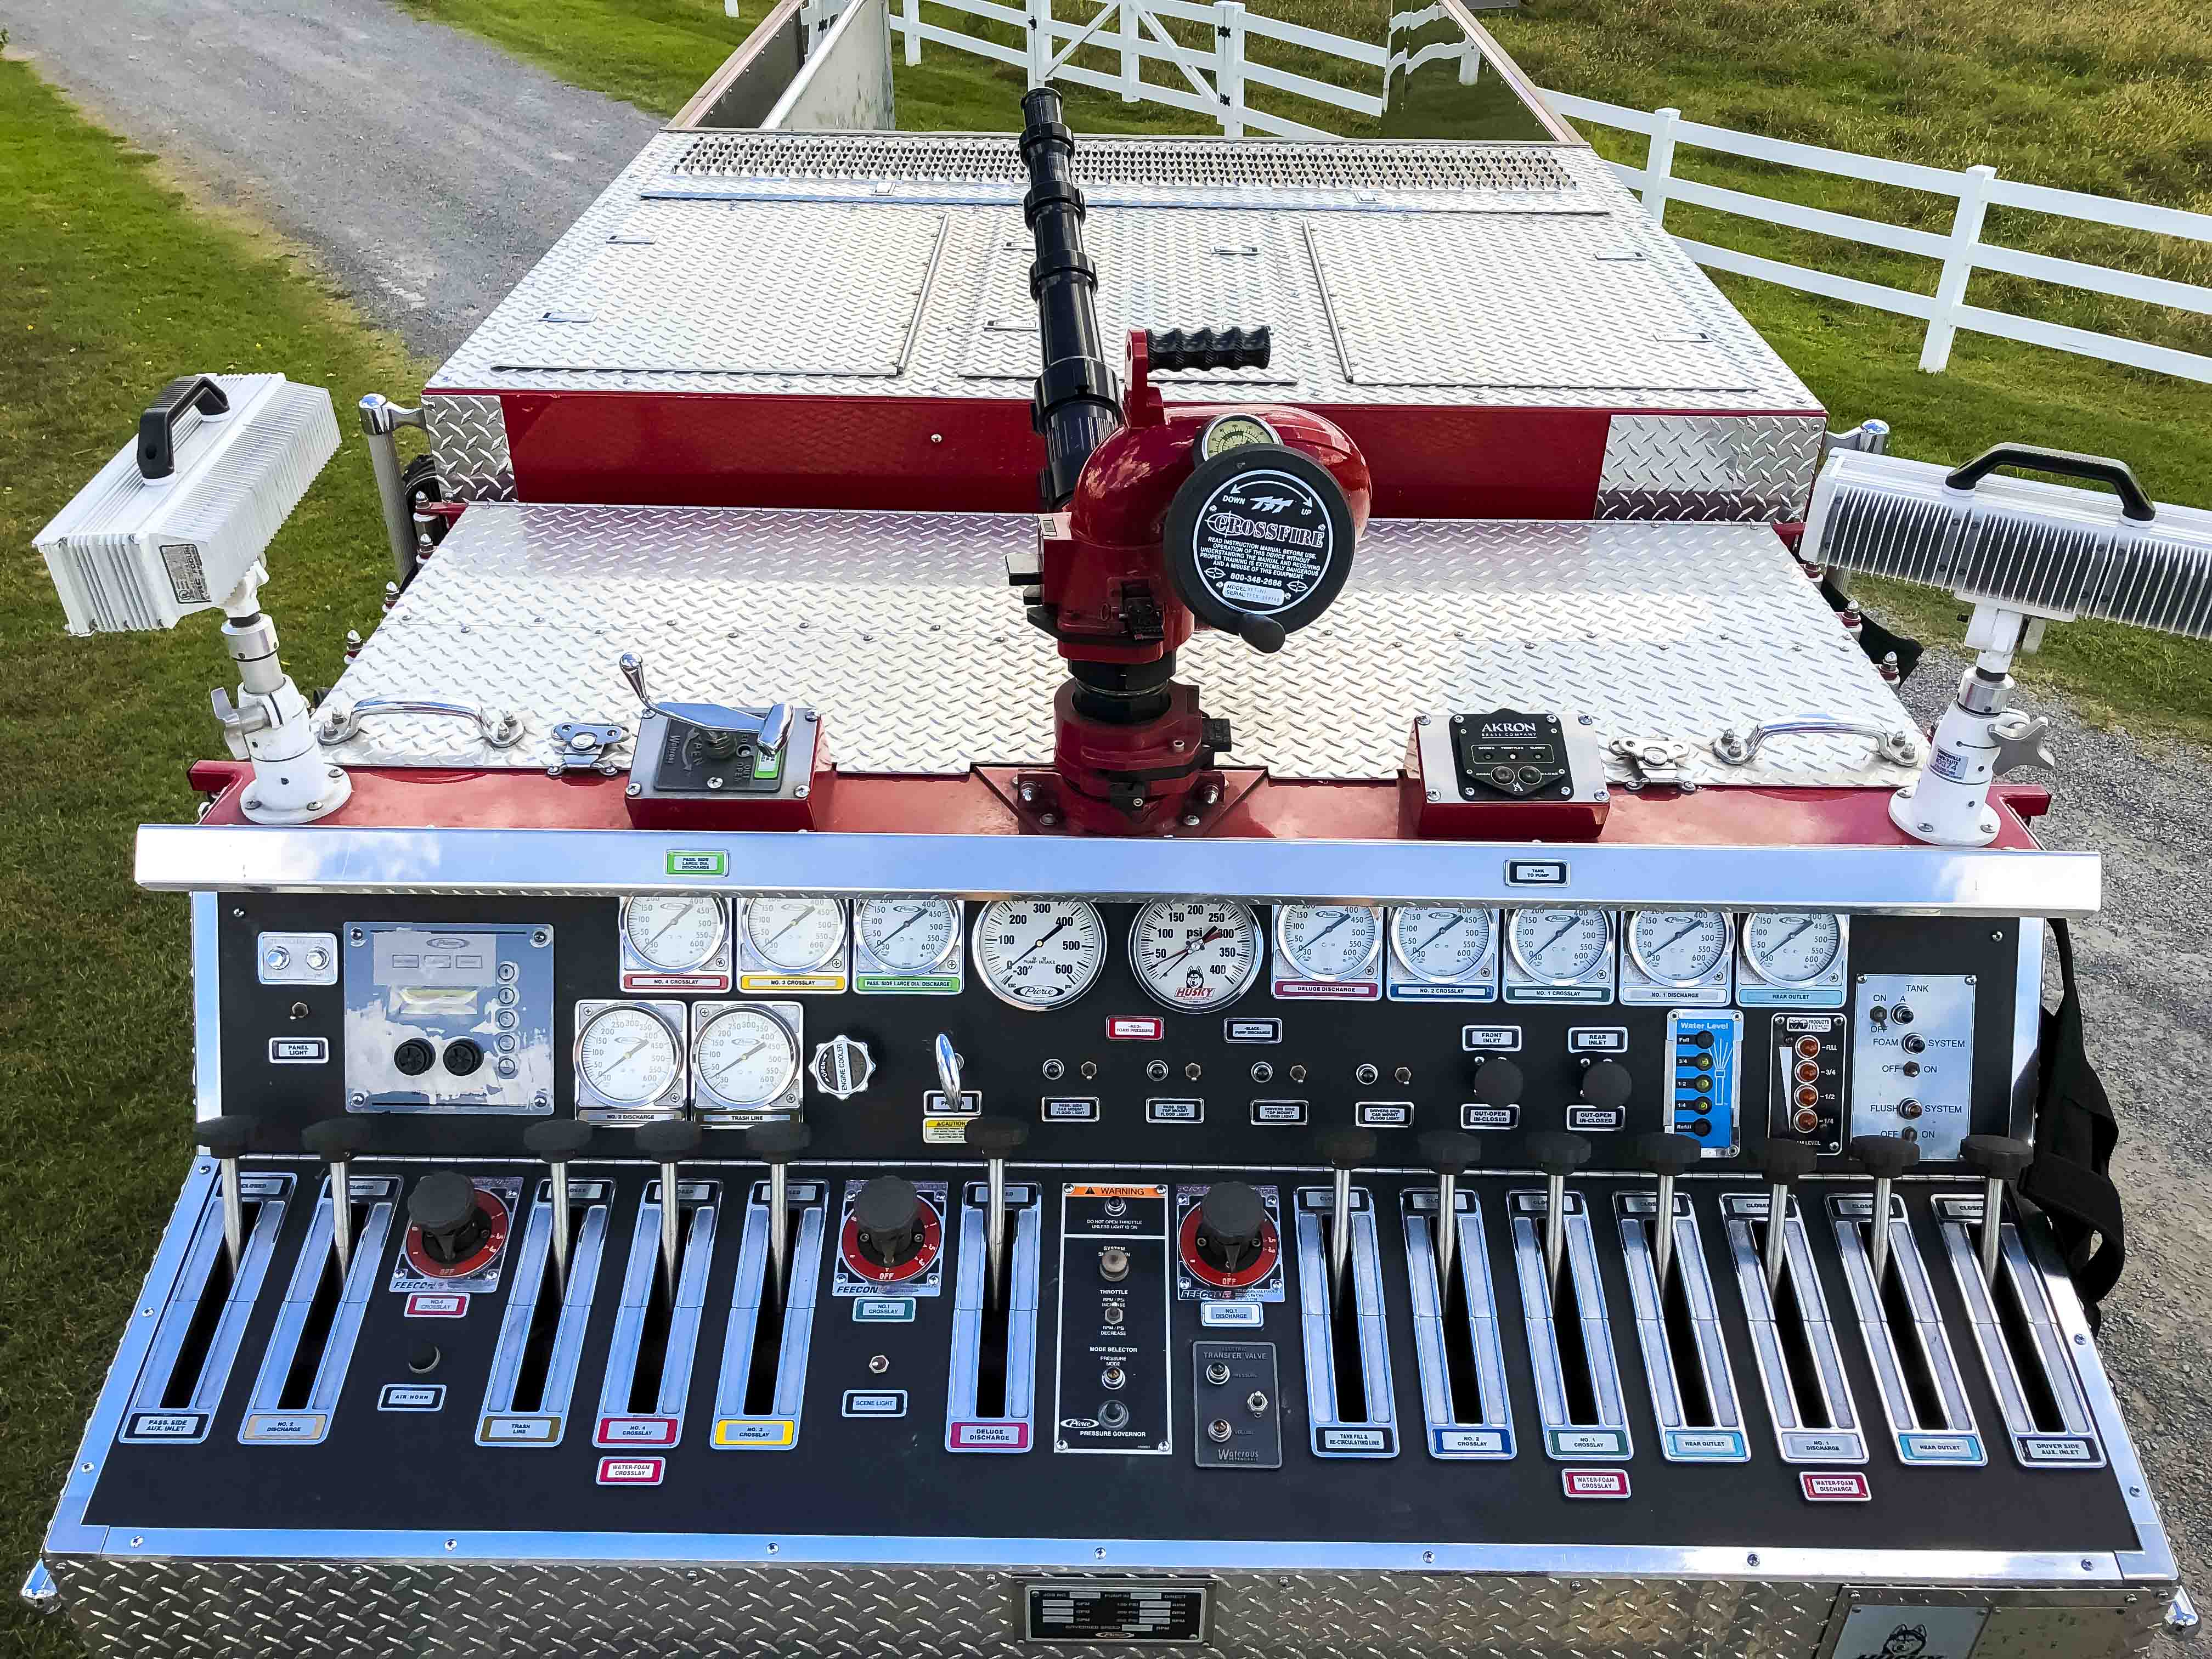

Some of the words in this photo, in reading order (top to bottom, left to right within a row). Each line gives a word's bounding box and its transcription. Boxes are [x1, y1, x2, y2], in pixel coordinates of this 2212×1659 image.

[1222, 495, 1245, 505] DOWN
[1214, 514, 1325, 548] CROSSFIRE
[1223, 539, 1259, 550] INSTRUCTION
[1260, 545, 1282, 554] MANUAL
[1283, 549, 1304, 557] BEFORE
[1200, 546, 1245, 558] UNDERSTANDING
[1257, 556, 1279, 565] MANUAL
[1292, 562, 1321, 571] RECEIVING
[1213, 543, 1243, 553] OPERATION
[1286, 555, 1310, 564] WITHOUT
[1200, 552, 1221, 560] PROPER
[1223, 556, 1248, 565] TRAINING
[1255, 561, 1285, 571] EXTREMELY
[1286, 566, 1319, 576] DANGEROUS
[1231, 563, 1250, 571] MISUSE
[1273, 569, 1304, 580] EQUIPMENT.
[1481, 723, 1536, 732] AKRON
[1032, 904, 1051, 913] 300
[1187, 905, 1204, 915] 200
[1009, 915, 1028, 925] 200
[1055, 916, 1074, 927] 400
[1168, 912, 1184, 923] 150
[1208, 912, 1226, 923] 250
[1157, 928, 1173, 939] 100
[1186, 928, 1203, 939] psi
[998, 934, 1015, 945] 100
[1062, 940, 1080, 951] 500
[1155, 949, 1166, 958] 50
[1219, 947, 1236, 957] 350
[1054, 964, 1073, 974] 600
[1209, 964, 1226, 975] 400
[1024, 986, 1054, 996] Pierce
[1176, 988, 1215, 997] HUSKY
[1905, 984, 1928, 992] TANK
[1873, 994, 1887, 1002] ON
[1873, 1039, 1898, 1047] FOAM
[1928, 1039, 1965, 1048] SYSTEM
[837, 1043, 845, 1068] COOLER
[1882, 1065, 1899, 1073] OFF
[1923, 1065, 1937, 1074] ON
[839, 1069, 848, 1091] ENGINE
[1870, 1104, 1898, 1113] FLUSH
[1925, 1104, 1962, 1113] SYSTEM
[1921, 1130, 1935, 1138] ON
[1101, 1187, 1145, 1195] WARNING
[1203, 1351, 1242, 1359] TRANSFER
[1218, 1448, 1259, 1461] Waterous
